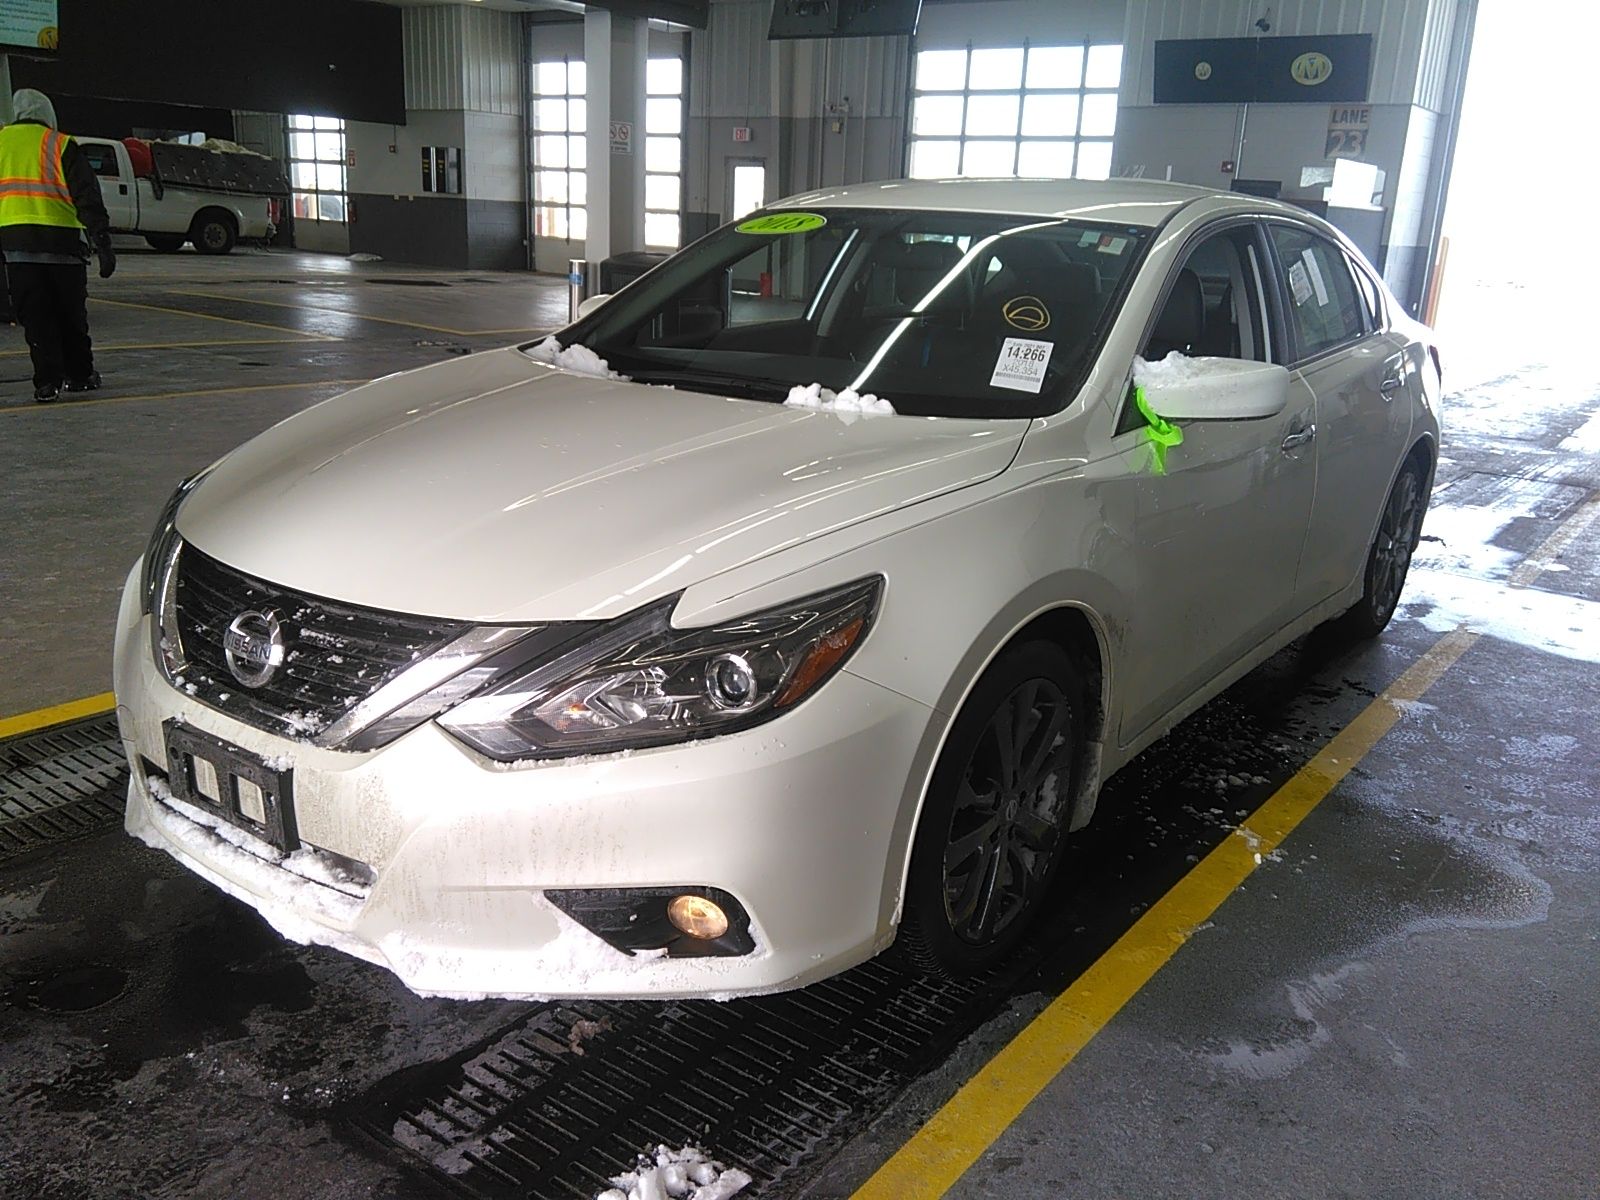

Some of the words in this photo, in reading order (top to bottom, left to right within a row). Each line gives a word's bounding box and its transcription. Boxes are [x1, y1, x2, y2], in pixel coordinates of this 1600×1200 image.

[1332, 109, 1369, 124] LANE
[1327, 130, 1362, 158] 23
[1007, 346, 1046, 362] 14:266
